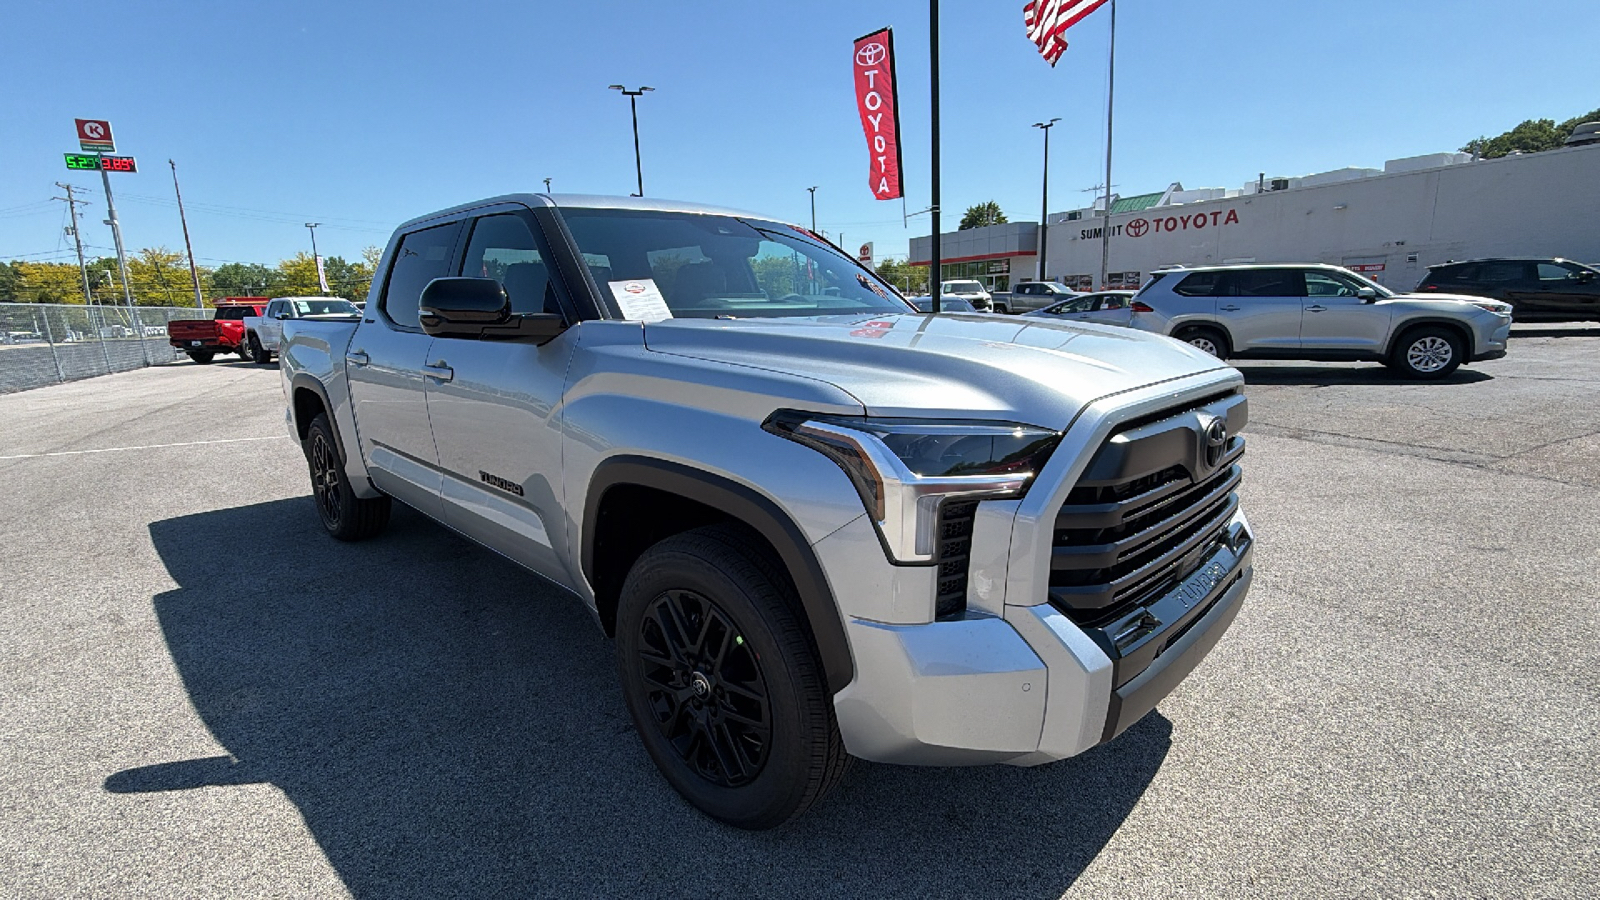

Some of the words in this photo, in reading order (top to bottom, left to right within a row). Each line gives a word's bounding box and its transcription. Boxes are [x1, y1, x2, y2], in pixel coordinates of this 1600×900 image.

[864, 69, 890, 193] TOYOTA
[1153, 209, 1239, 233] TOYOTA
[479, 470, 524, 496] TUNDRA
[1171, 561, 1227, 608] TUNDRA
